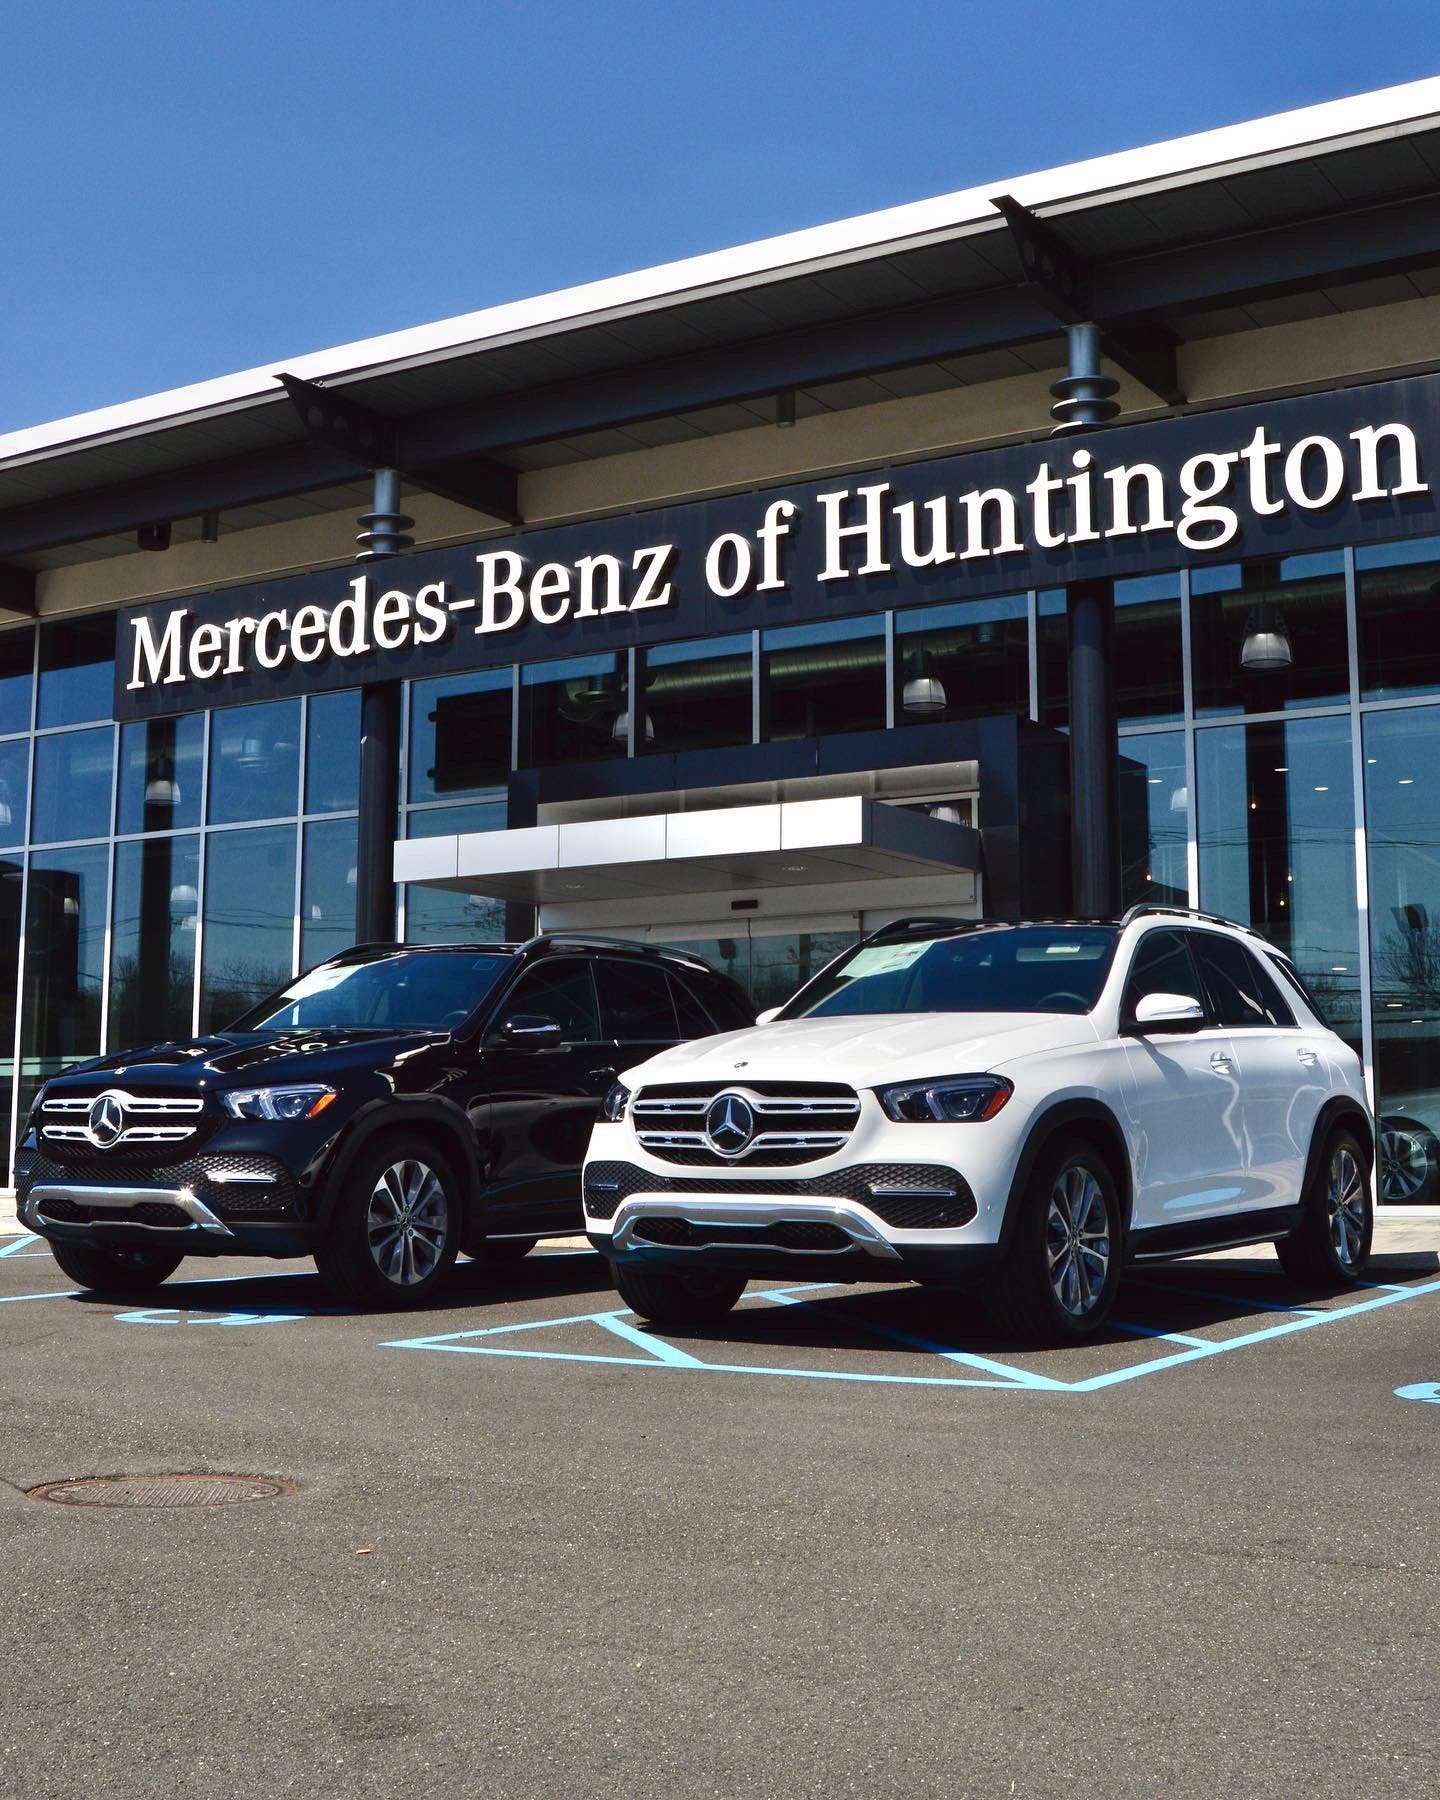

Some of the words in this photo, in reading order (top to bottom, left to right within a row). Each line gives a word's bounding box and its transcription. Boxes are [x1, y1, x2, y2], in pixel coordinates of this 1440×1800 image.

[126, 544, 673, 690] Mercedes-Benz
[705, 499, 798, 598] of
[816, 422, 1429, 582] Huntington
